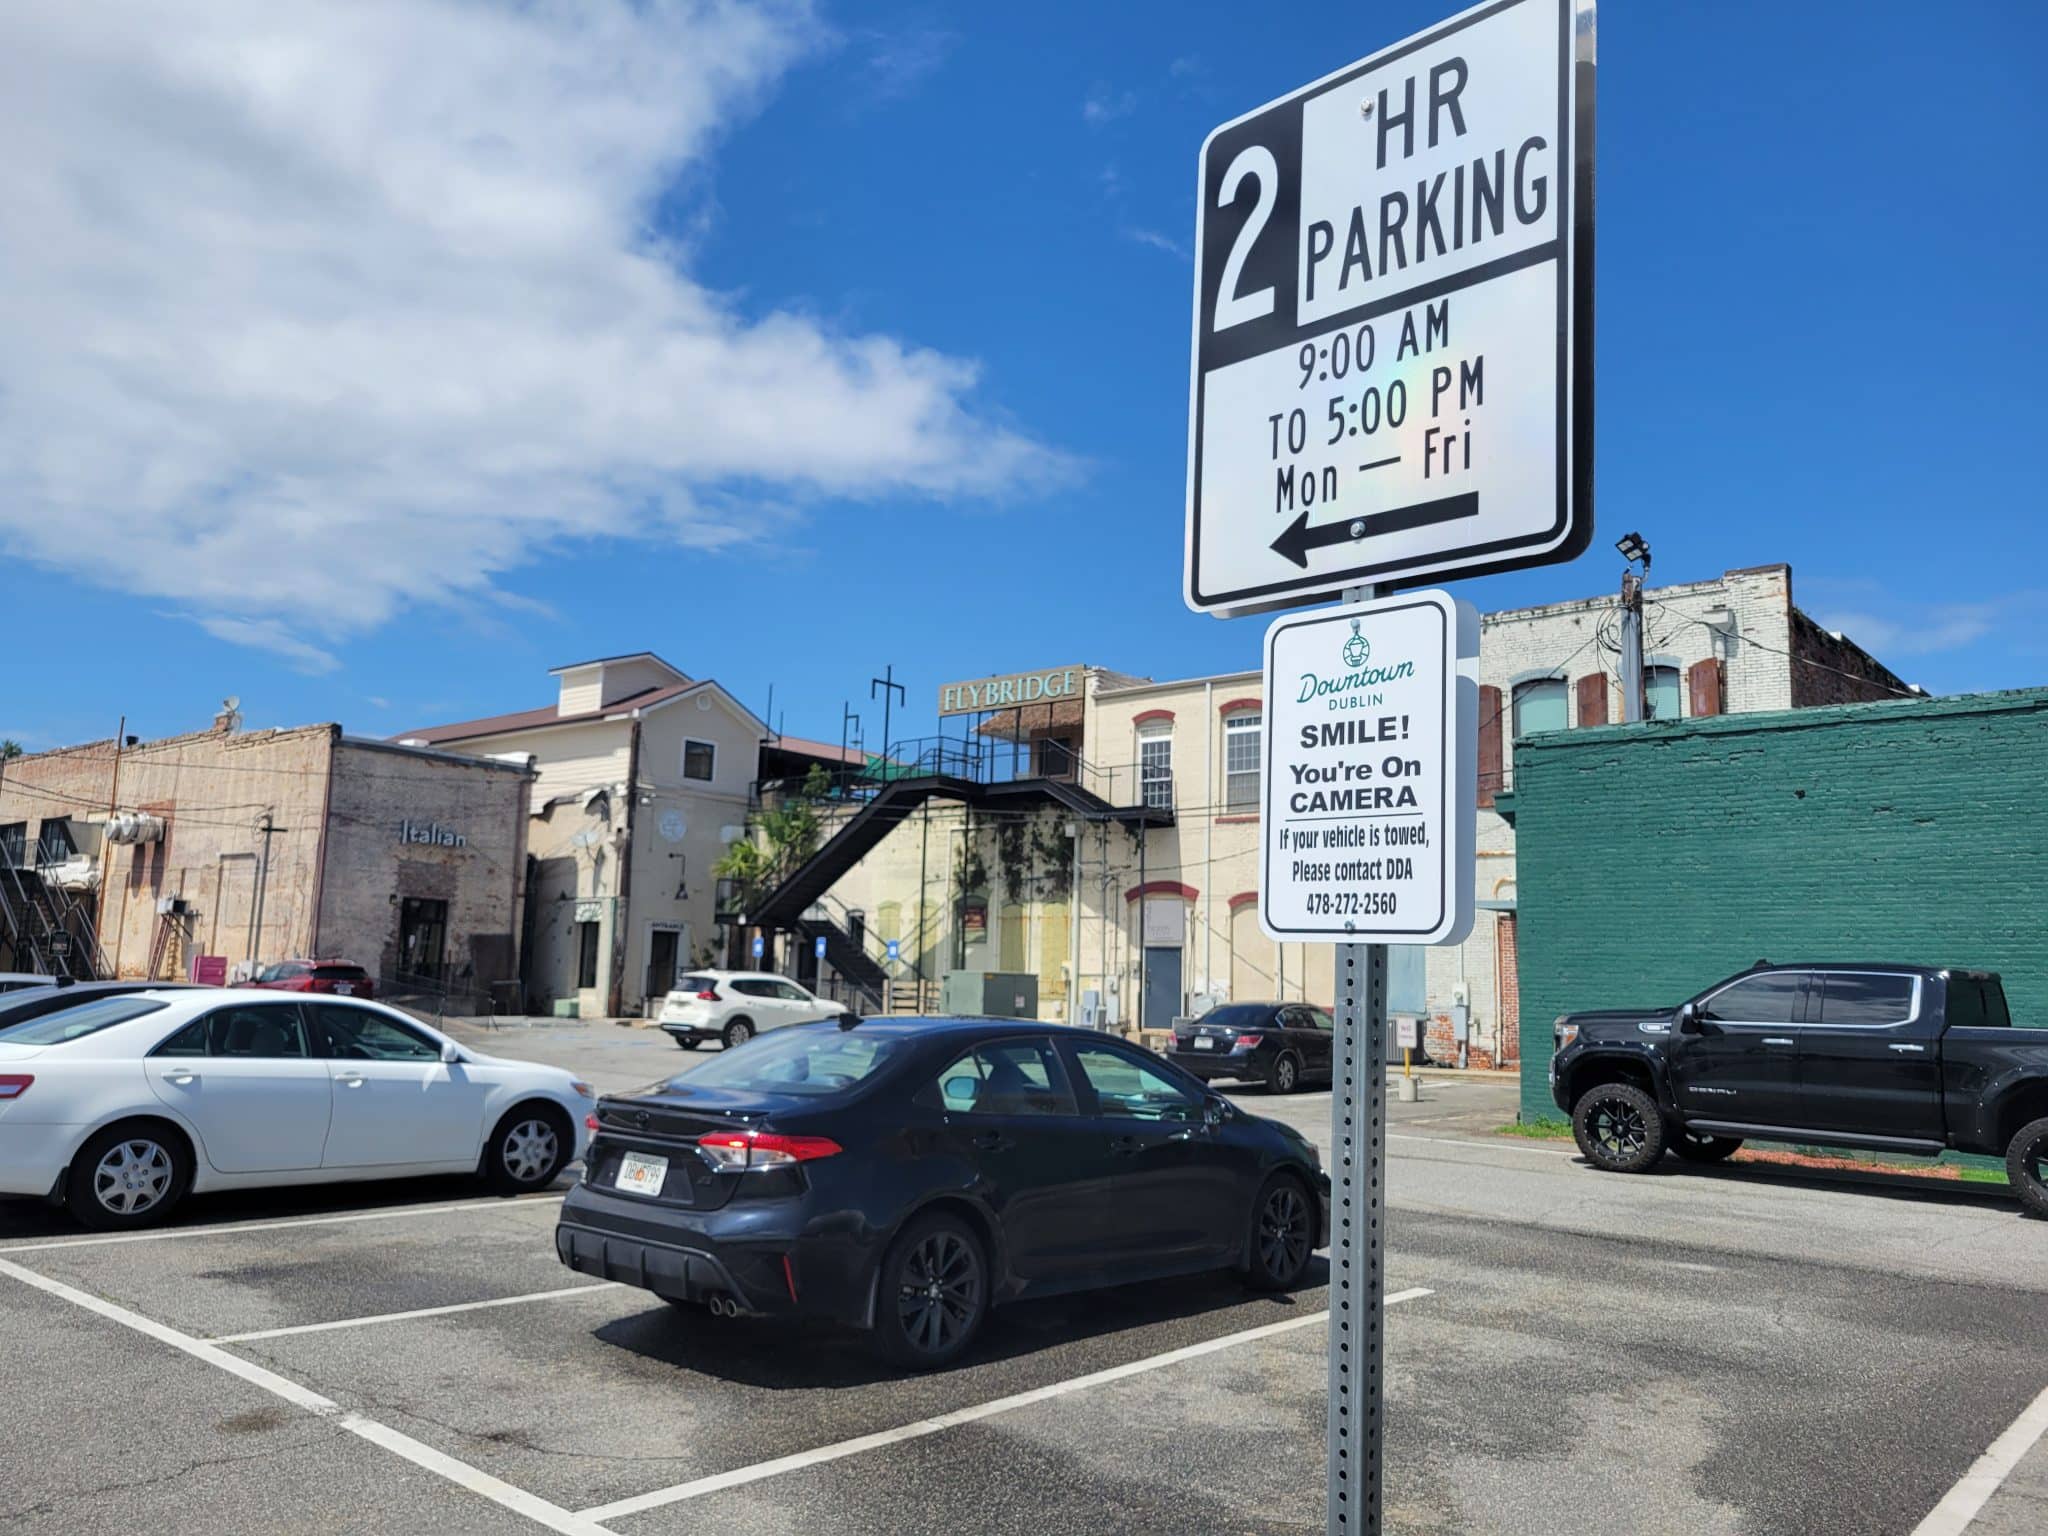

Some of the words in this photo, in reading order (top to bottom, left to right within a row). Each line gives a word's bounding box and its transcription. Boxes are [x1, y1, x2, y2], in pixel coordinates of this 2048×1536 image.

[1376, 56, 1469, 170] HR
[1305, 135, 1549, 303] PARKING
[1212, 144, 1279, 334] 2
[1298, 323, 1376, 390] 9:00
[1396, 298, 1449, 362] AM
[1268, 407, 1306, 460] TO
[1327, 379, 1408, 446] 5:00
[1431, 355, 1485, 418] PM
[1275, 464, 1338, 514] Mon
[1423, 418, 1472, 480] Fri
[942, 670, 1077, 712] FLYBRIDGE
[1296, 660, 1415, 704] Downtown
[1328, 693, 1383, 711] DUBLIN
[1299, 714, 1410, 750] SMILE!
[1289, 759, 1373, 785] You're
[1381, 756, 1422, 778] On
[1289, 785, 1419, 814] CAMERA
[400, 819, 467, 847] Italian
[1279, 827, 1289, 850] If
[1292, 832, 1319, 854] your
[1322, 824, 1366, 849] vehicle
[1369, 823, 1380, 847] is
[1384, 821, 1430, 849] towed,
[1292, 859, 1331, 882] Please
[1334, 858, 1382, 881] contact
[1386, 857, 1413, 880] DDA
[1306, 892, 1397, 915] 478-272-2560
